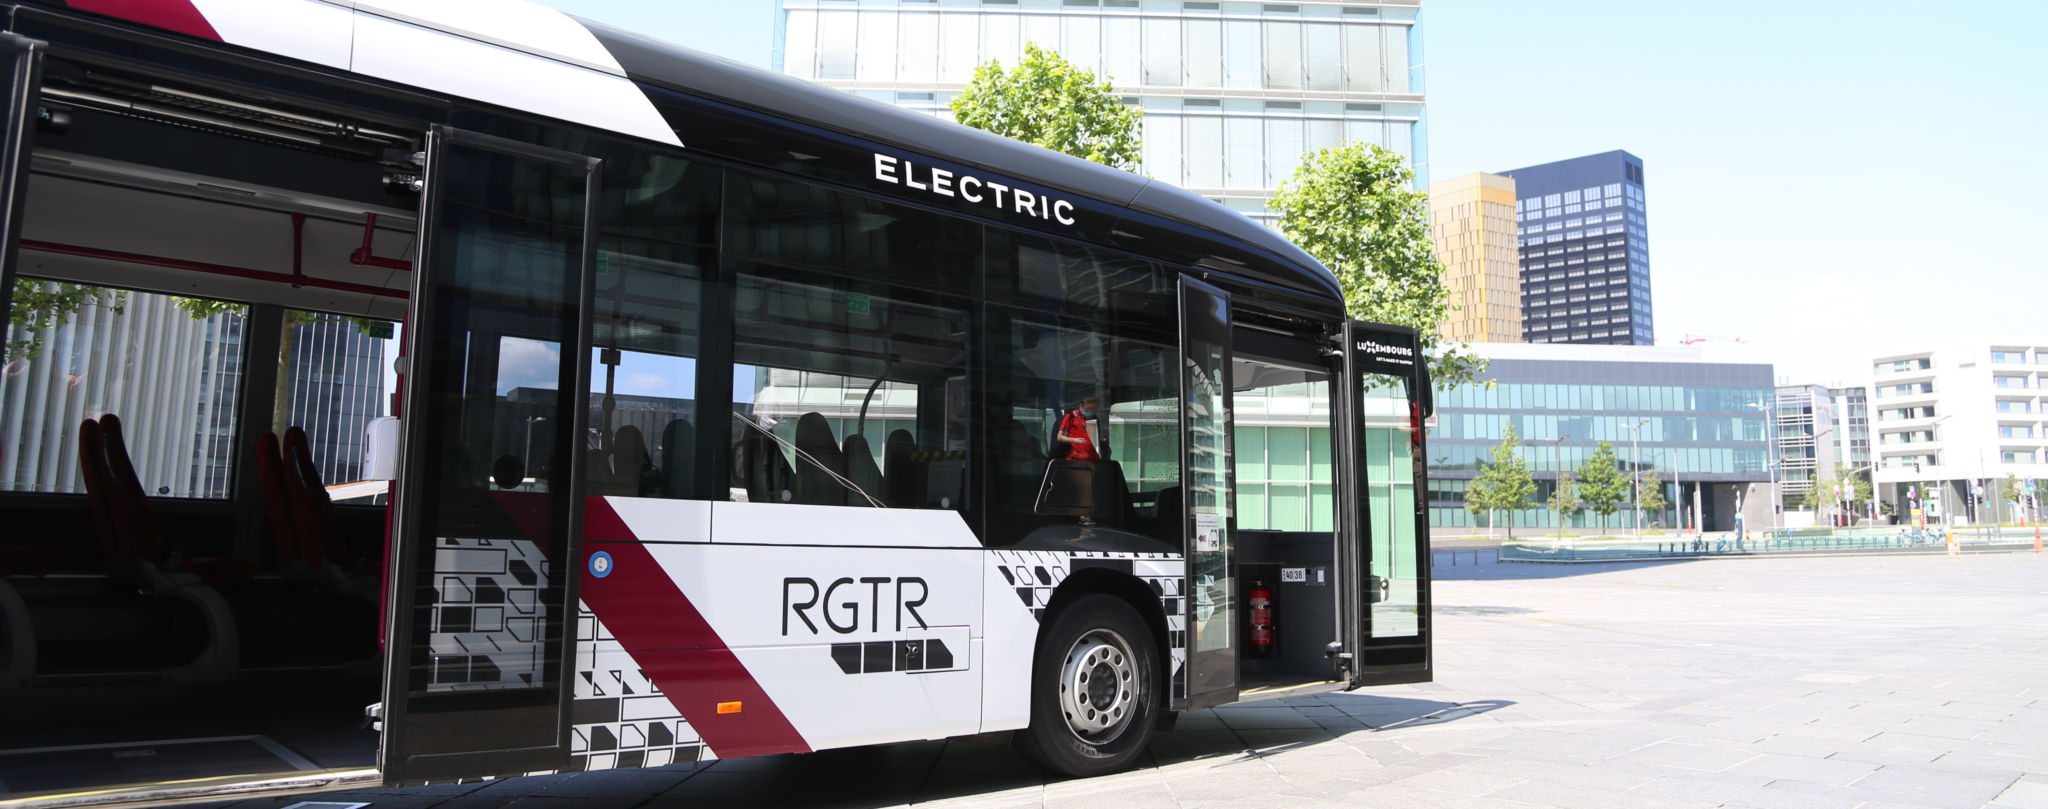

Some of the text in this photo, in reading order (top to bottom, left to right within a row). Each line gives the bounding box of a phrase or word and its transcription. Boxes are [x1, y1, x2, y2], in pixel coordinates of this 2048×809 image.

[874, 153, 1075, 226] ELECTRIC
[1357, 341, 1412, 356] LUXEMBOURG
[782, 577, 928, 636] RGTR
